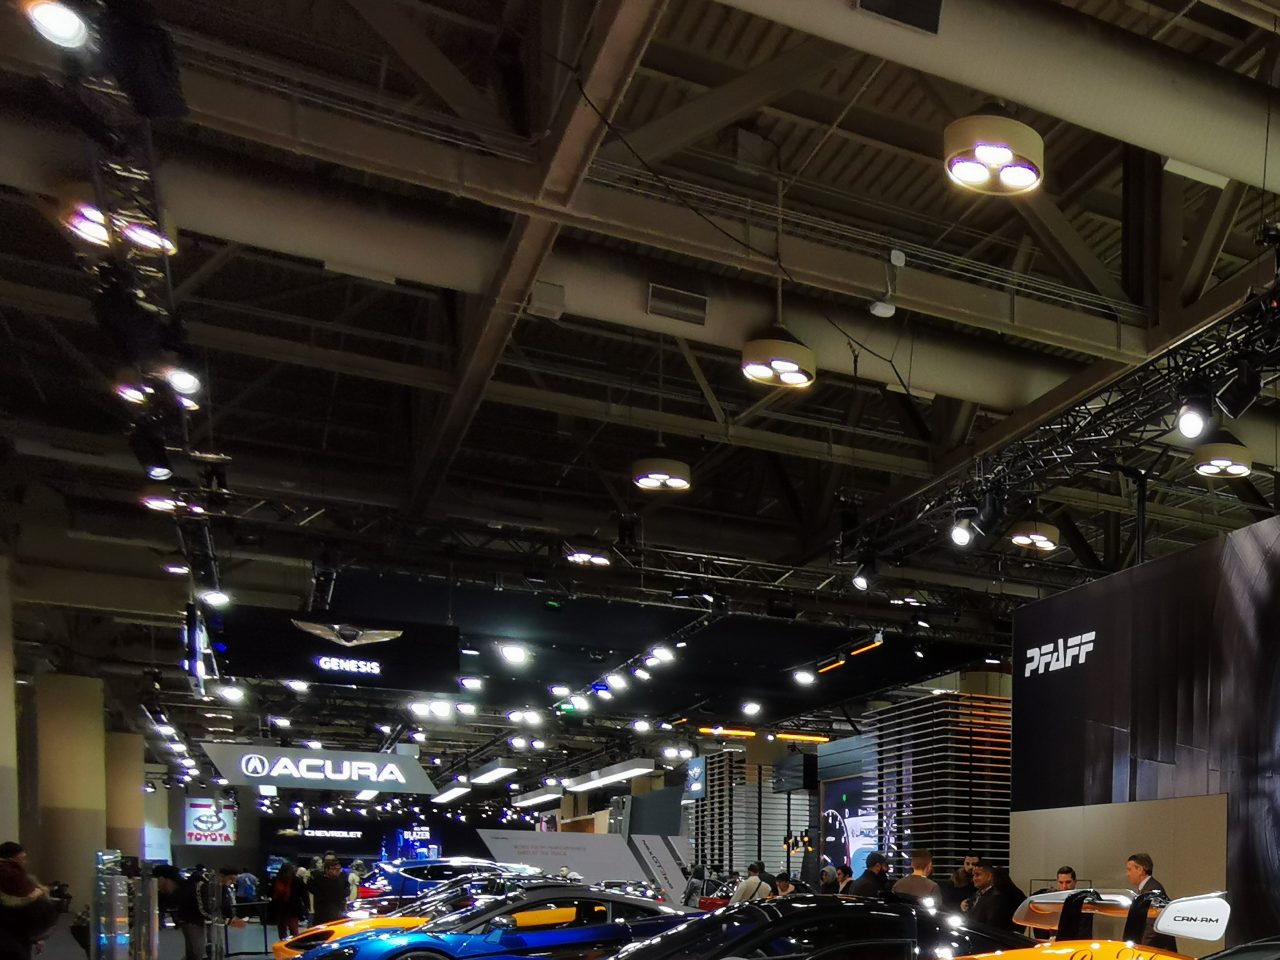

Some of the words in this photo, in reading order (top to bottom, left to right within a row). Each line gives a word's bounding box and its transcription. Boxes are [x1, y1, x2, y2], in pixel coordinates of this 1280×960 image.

[1024, 631, 1096, 678] PFAFF
[318, 656, 381, 675] GENESIS
[269, 757, 407, 784] ACURA
[187, 832, 233, 843] TOYOTA
[303, 829, 363, 839] CHEVROLET
[403, 831, 431, 840] BLAZER
[1172, 915, 1220, 924] CAN-AM
